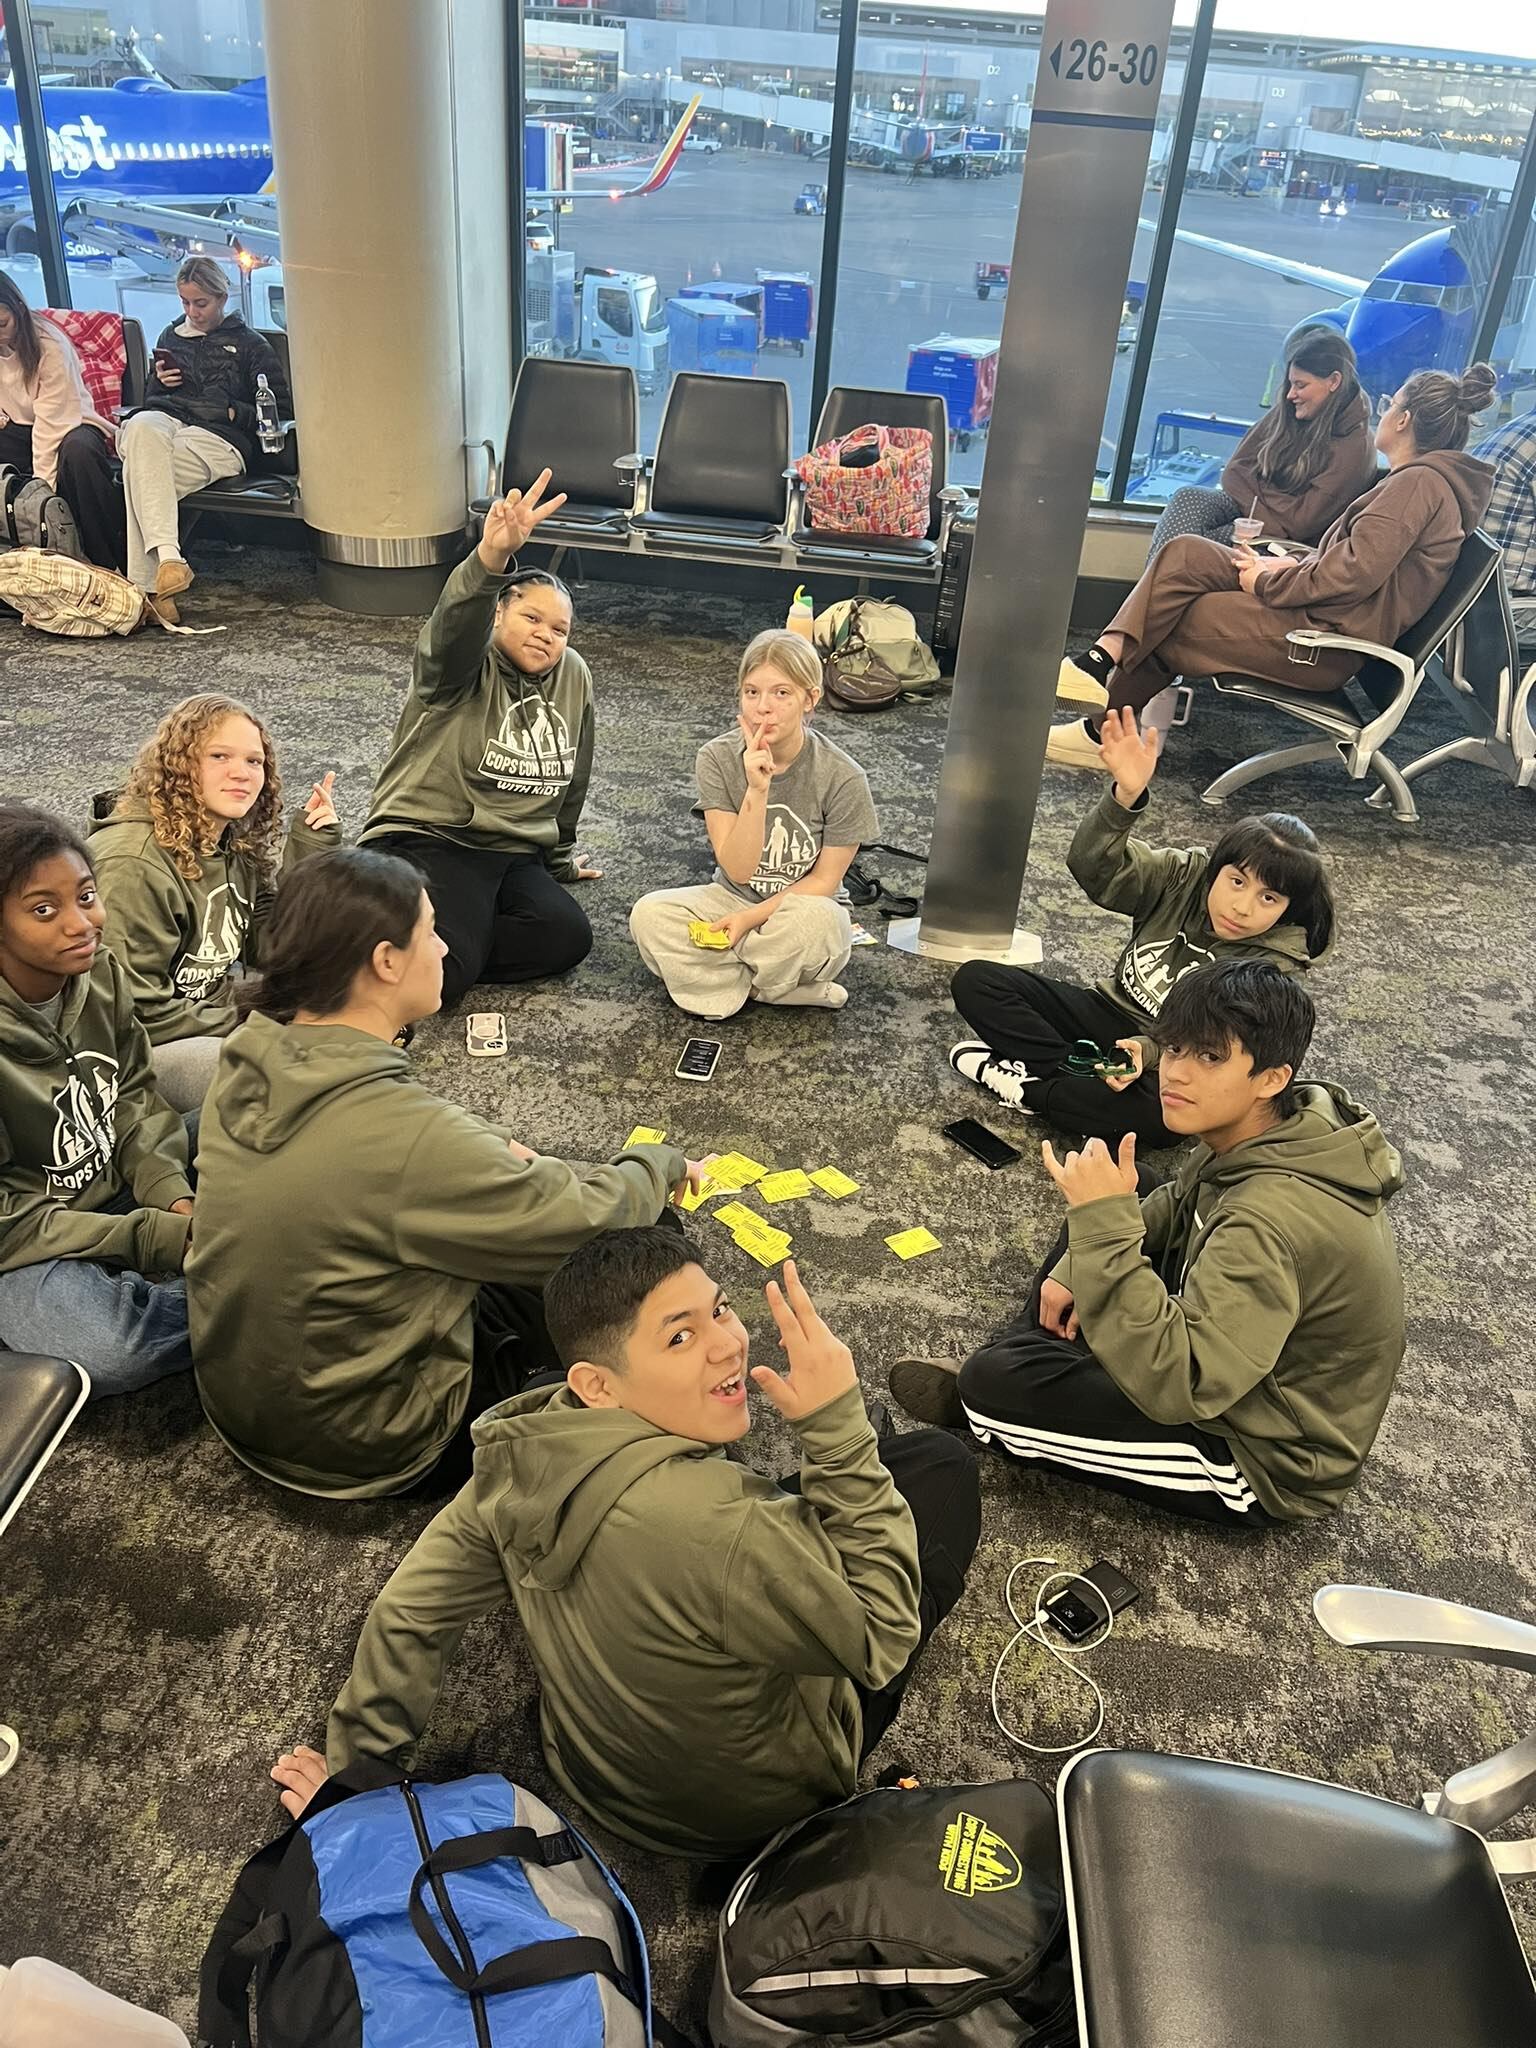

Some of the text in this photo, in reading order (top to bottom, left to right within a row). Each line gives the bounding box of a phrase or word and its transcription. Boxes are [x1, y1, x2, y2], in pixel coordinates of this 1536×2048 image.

[987, 64, 1001, 76] D2
[1065, 38, 1159, 86] 26-30
[1271, 87, 1286, 98] D3
[485, 750, 574, 777] COPS CONECTNG
[497, 780, 532, 794] WITH
[51, 1162, 93, 1190] COPS
[953, 1817, 979, 1891] COPS CONNECTING
